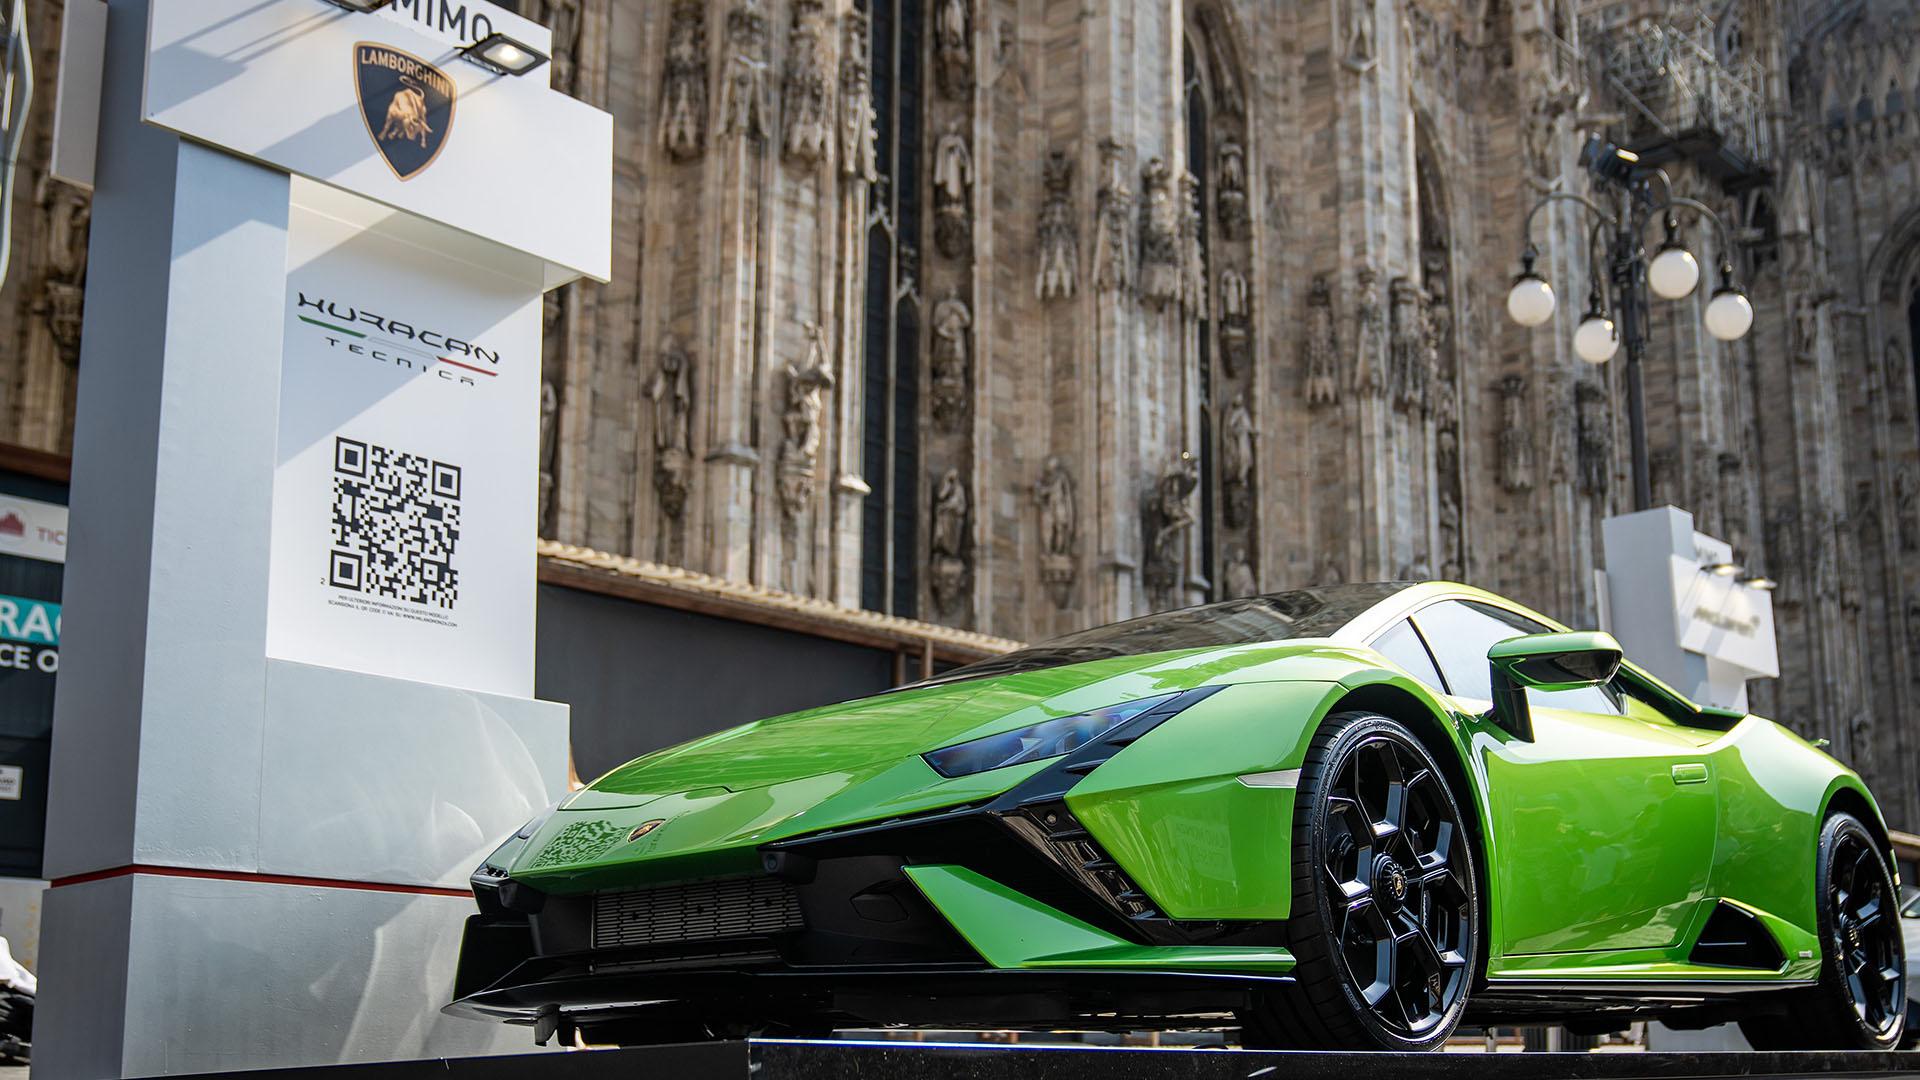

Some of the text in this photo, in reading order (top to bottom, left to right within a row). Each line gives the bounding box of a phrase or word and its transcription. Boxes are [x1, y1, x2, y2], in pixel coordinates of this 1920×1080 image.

[391, 0, 493, 42] MIMO
[361, 48, 451, 99] LAMBORGHINI
[325, 336, 475, 386] TECNICA
[320, 577, 326, 585] 2
